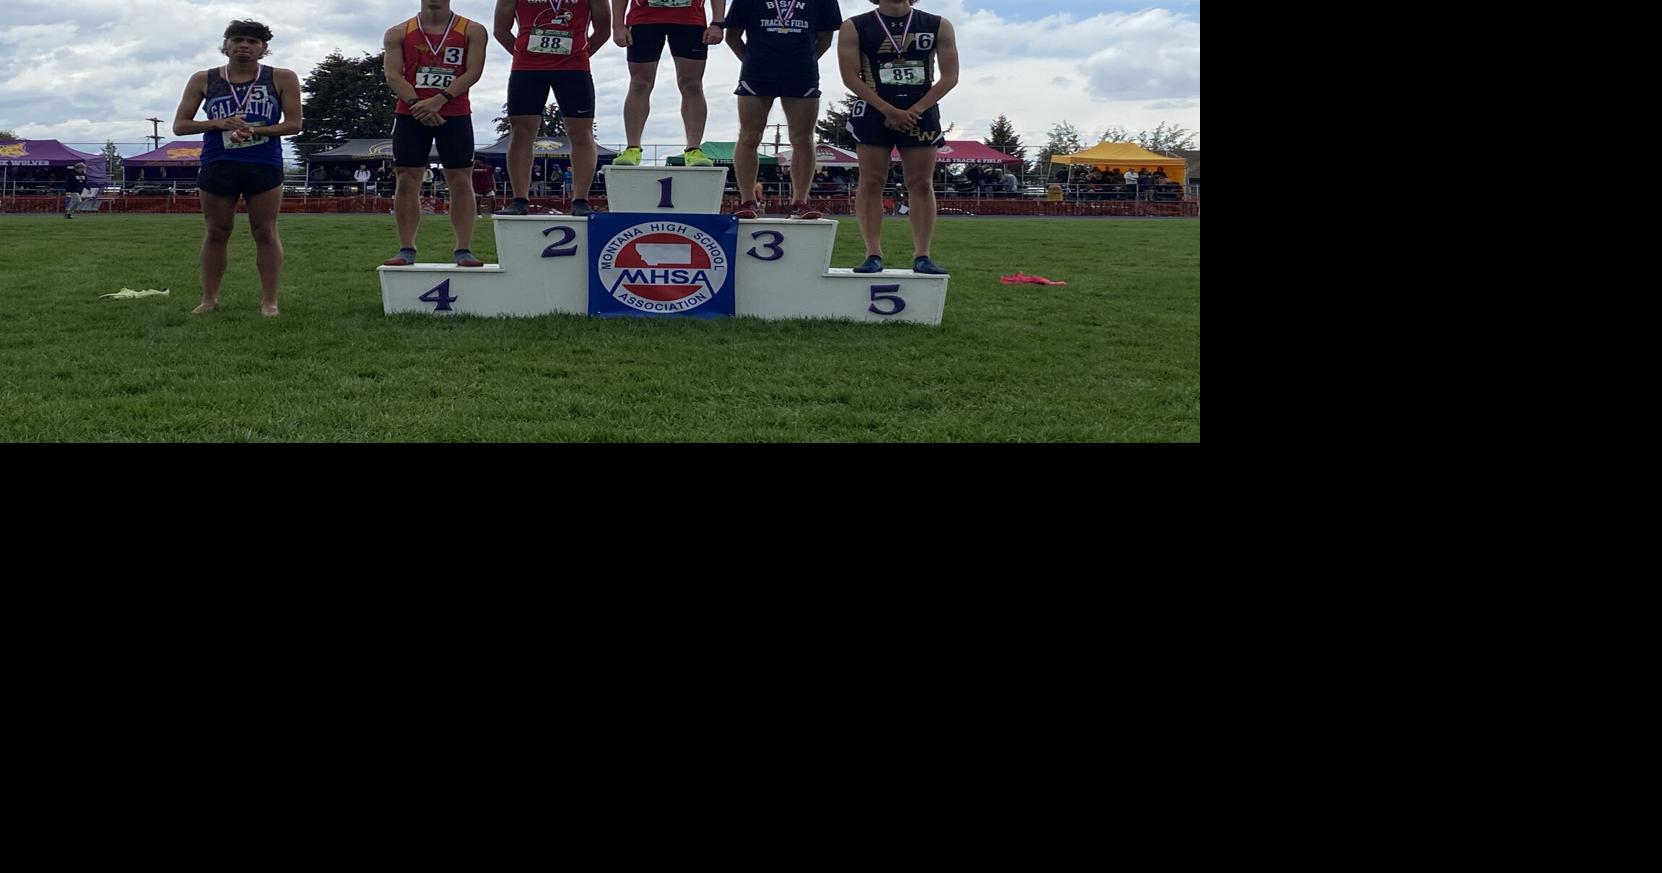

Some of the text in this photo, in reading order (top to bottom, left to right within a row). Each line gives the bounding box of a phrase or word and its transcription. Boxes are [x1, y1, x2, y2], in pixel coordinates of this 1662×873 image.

[791, 19, 809, 28] FIELD
[540, 36, 561, 49] 88
[918, 33, 931, 48] 6
[446, 48, 460, 63] 3
[420, 74, 453, 88] 126
[893, 68, 914, 81] 85
[251, 86, 265, 100] 5
[853, 101, 864, 116] 6
[657, 176, 674, 208] 1
[541, 225, 578, 258] 2
[601, 223, 725, 271] MONTANA HIGH SCHOOL
[746, 230, 785, 261] 3
[611, 269, 714, 288] MHSA
[418, 277, 458, 311] 4
[618, 292, 707, 311] ASSOCIATION
[868, 284, 906, 315] 5
